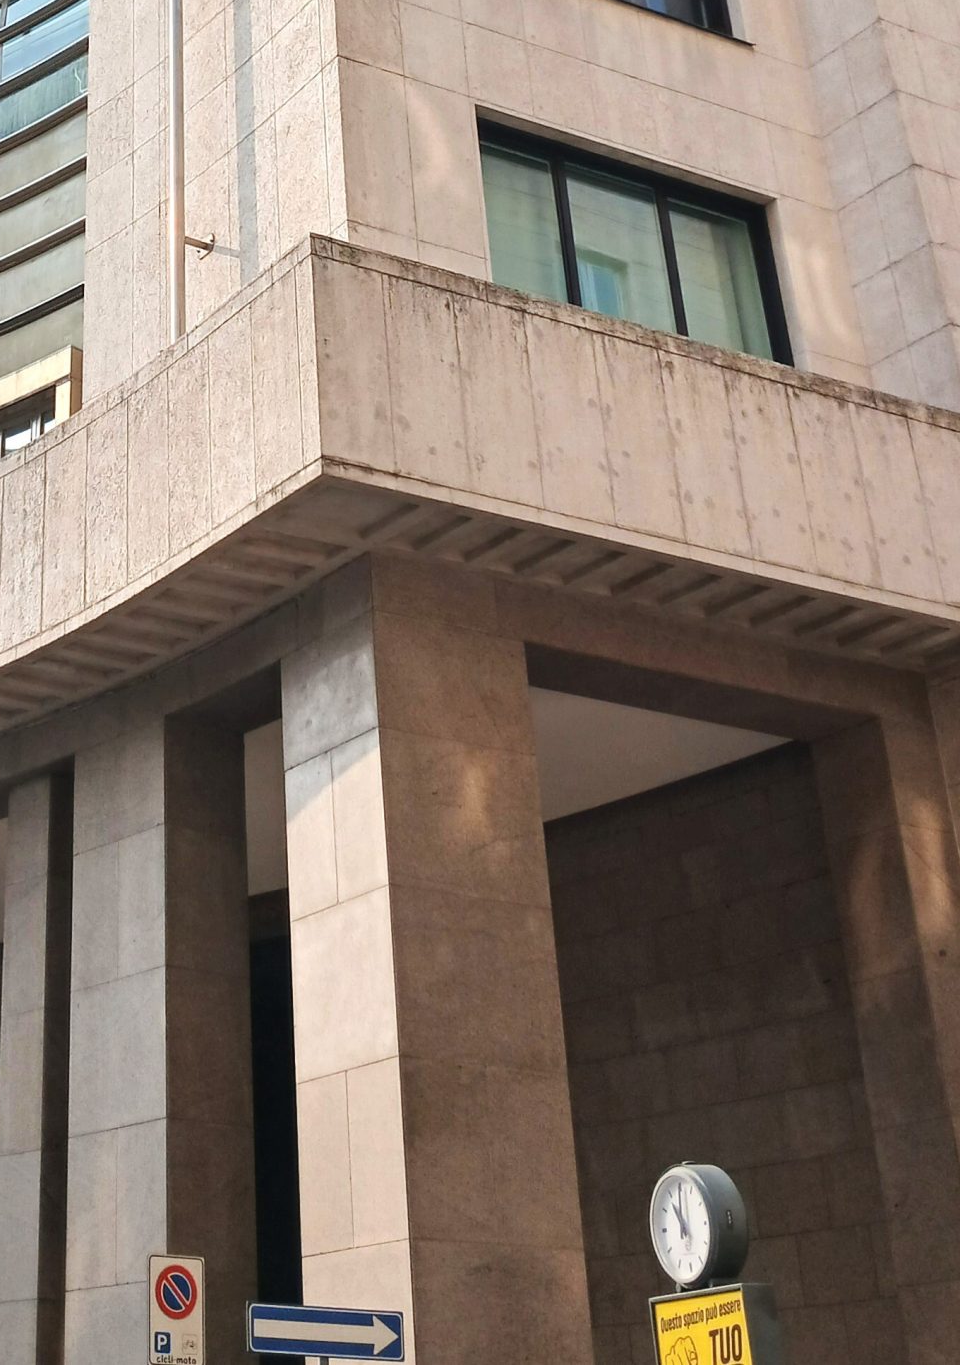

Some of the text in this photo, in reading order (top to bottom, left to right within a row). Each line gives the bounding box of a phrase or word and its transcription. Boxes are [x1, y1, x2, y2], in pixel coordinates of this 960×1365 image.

[660, 1299, 741, 1333] Questo spazio può essere
[157, 1334, 168, 1351] P
[708, 1324, 742, 1365] TUO
